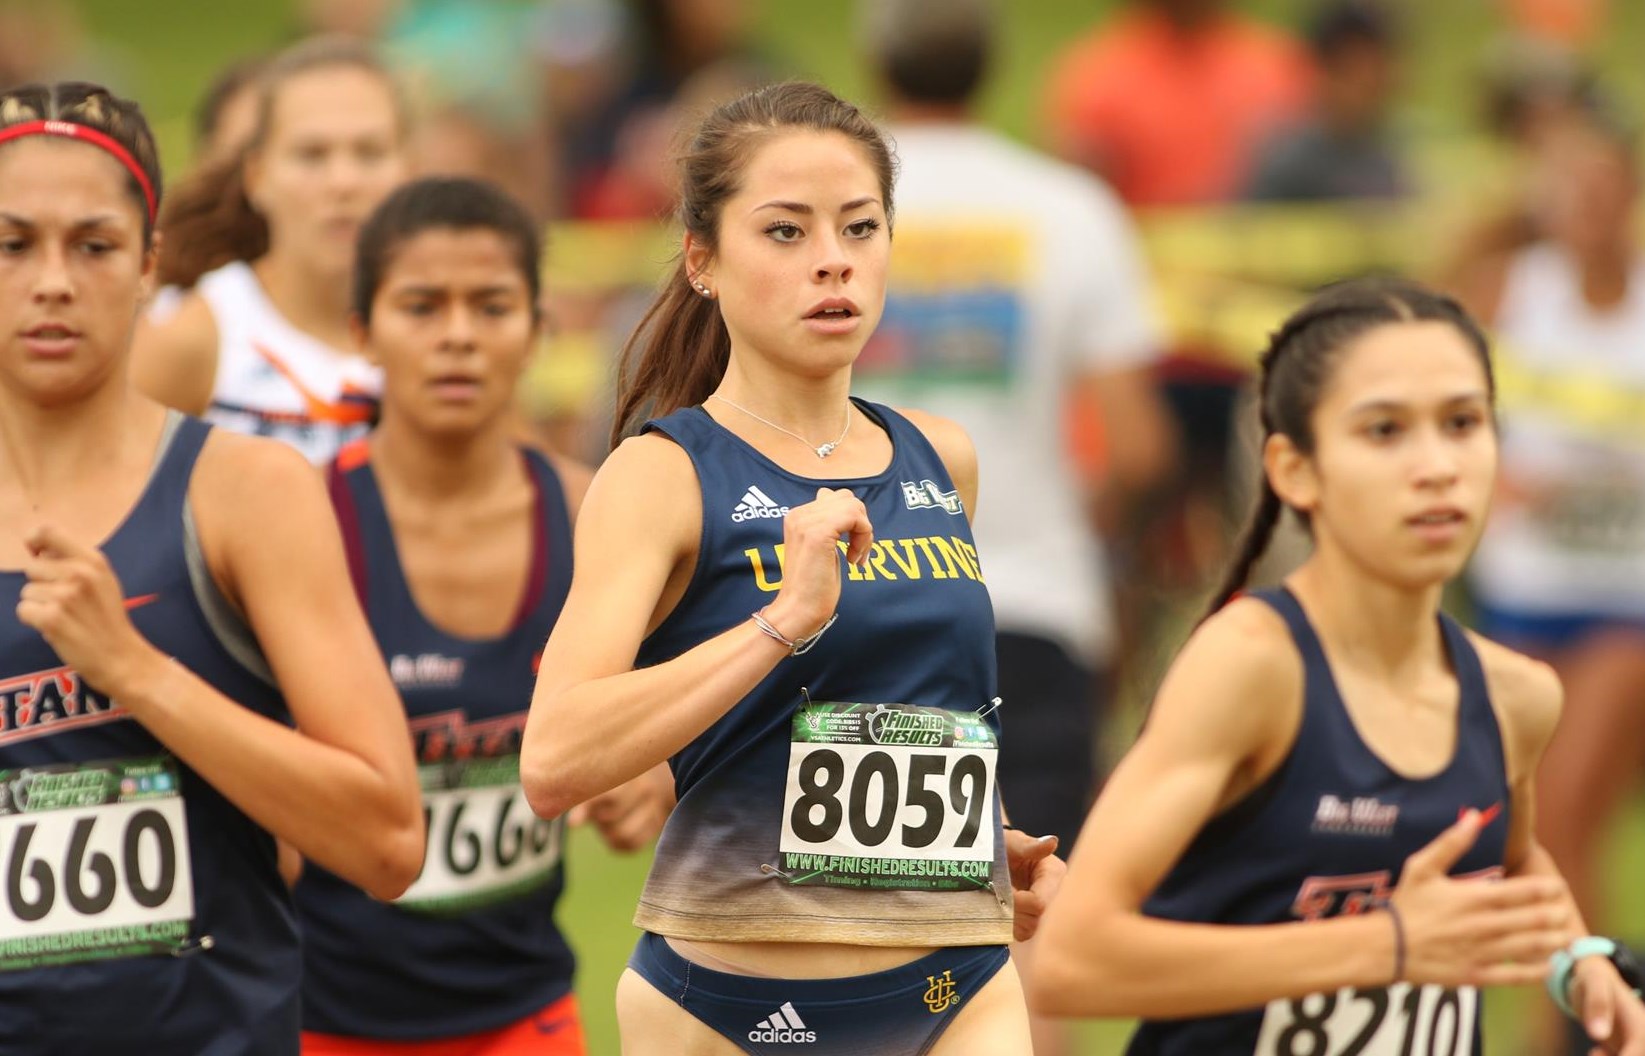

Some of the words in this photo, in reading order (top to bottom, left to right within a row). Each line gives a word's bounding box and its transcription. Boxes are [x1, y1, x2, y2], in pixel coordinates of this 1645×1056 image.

[731, 503, 790, 523] adidas
[886, 710, 943, 730] FINISHED
[880, 728, 942, 745] RESULTS
[791, 749, 987, 848] 8059
[786, 852, 990, 877] WWW.FINISHEDRESULTS.COM
[748, 1027, 817, 1043] adidas
